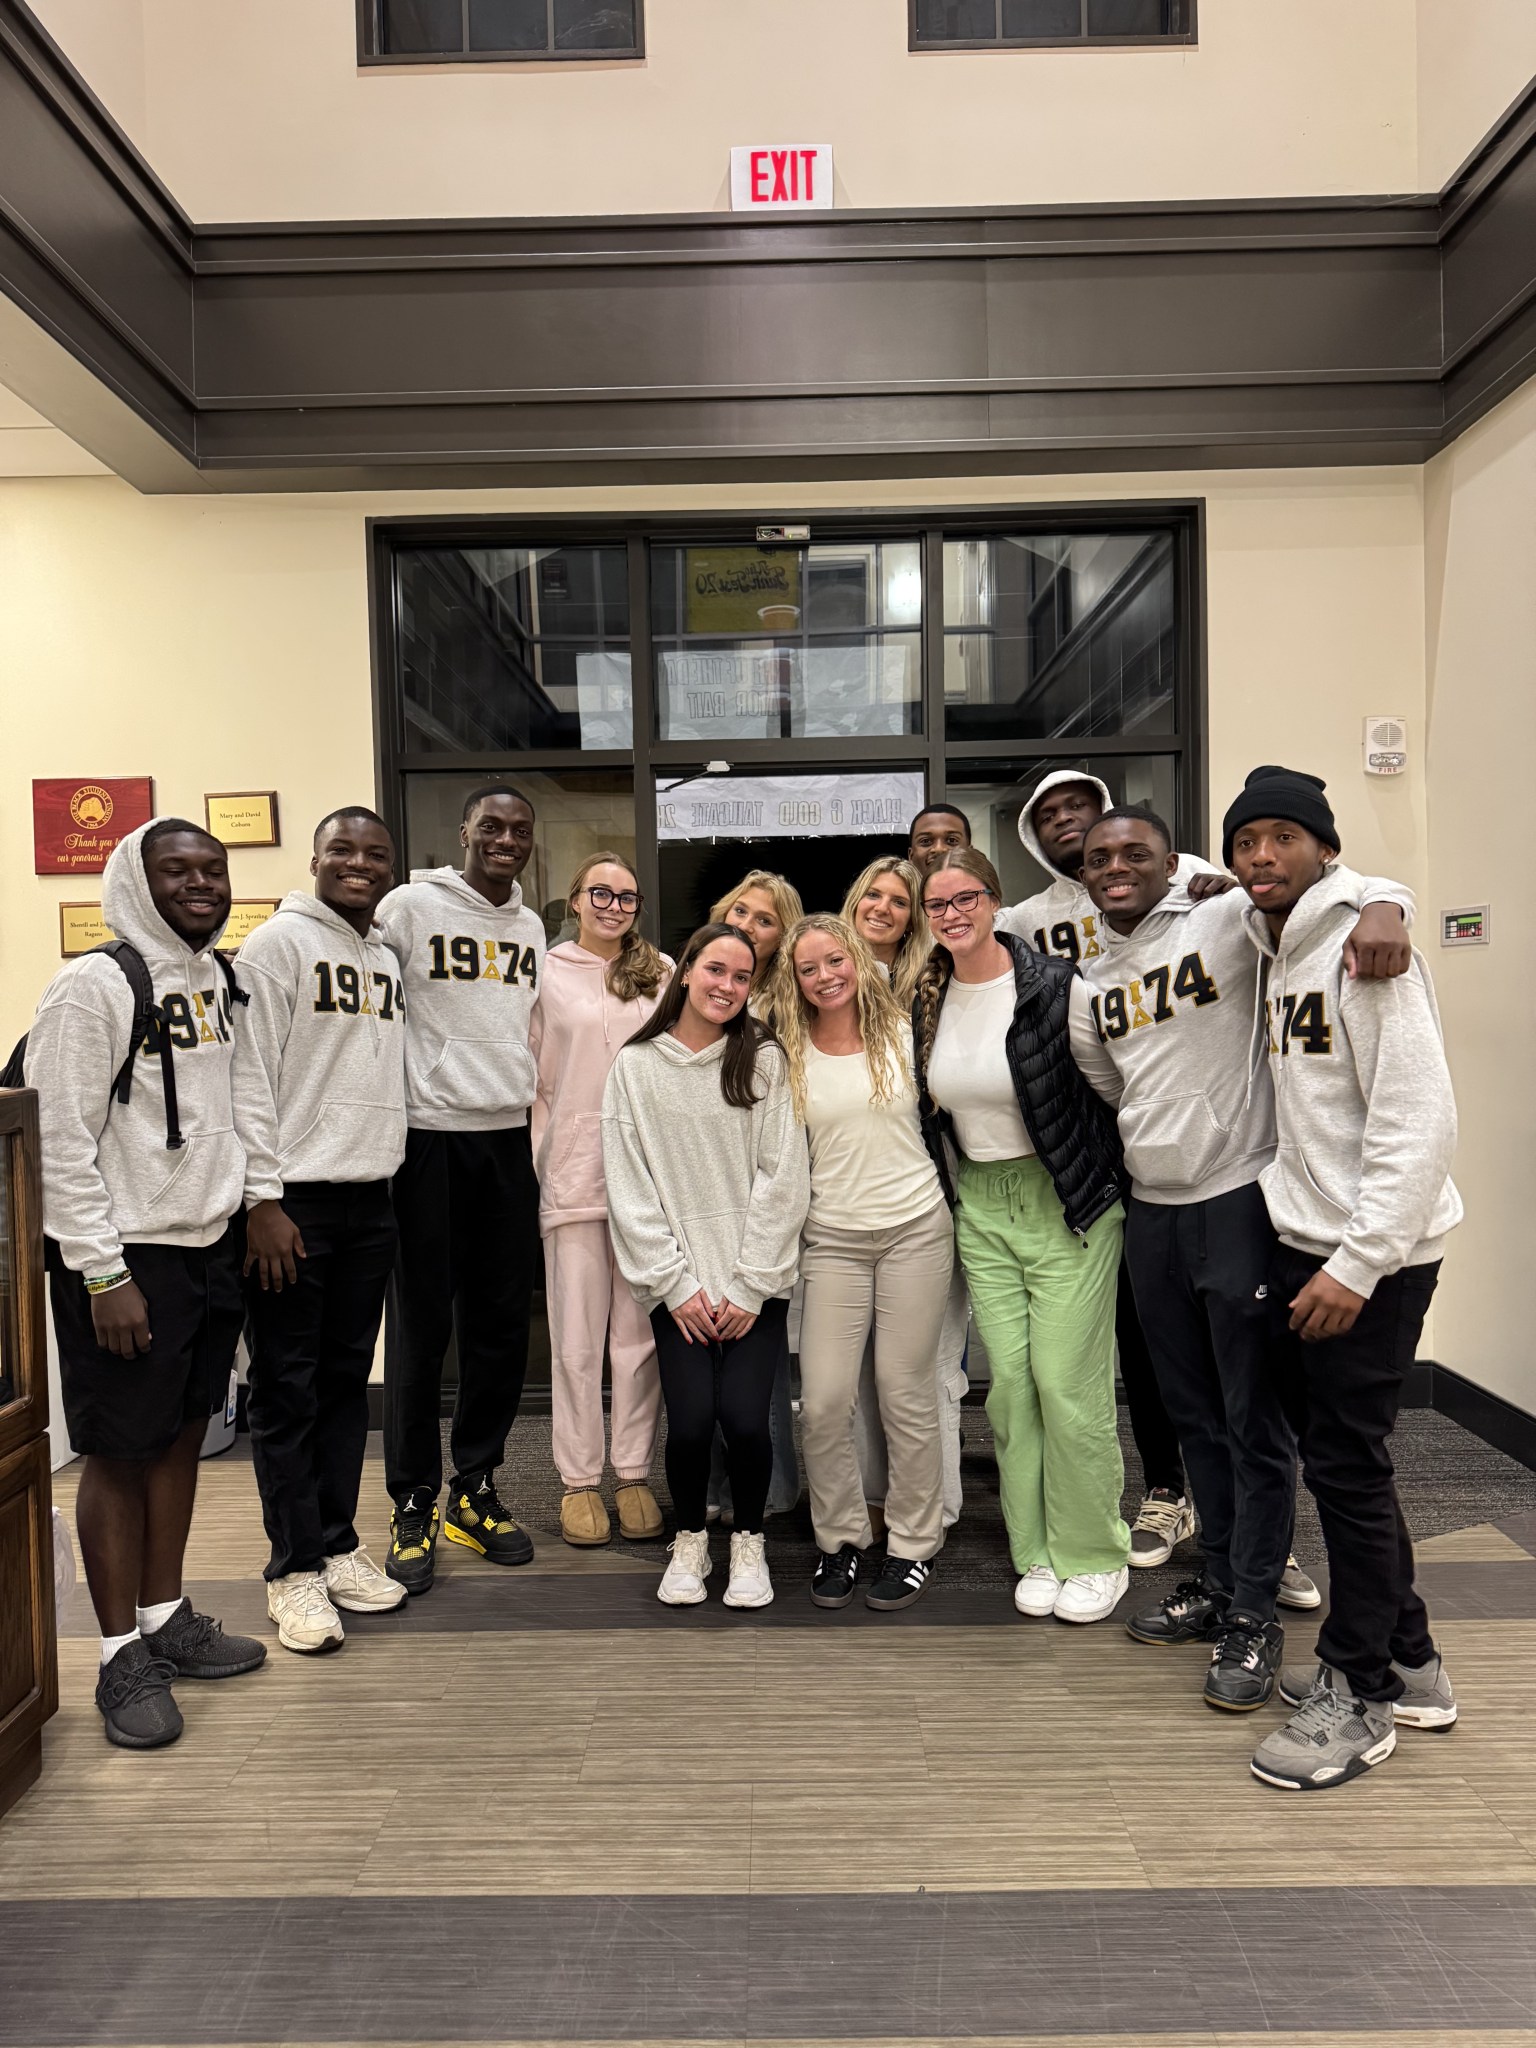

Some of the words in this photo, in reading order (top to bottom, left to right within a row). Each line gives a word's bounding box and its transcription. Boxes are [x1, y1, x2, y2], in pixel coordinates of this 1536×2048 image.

[750, 150, 818, 203] EXIT
[219, 812, 233, 820] Mary
[64, 832, 98, 850] Thank
[99, 840, 113, 852] you
[57, 854, 69, 863] our
[71, 853, 104, 867] generous
